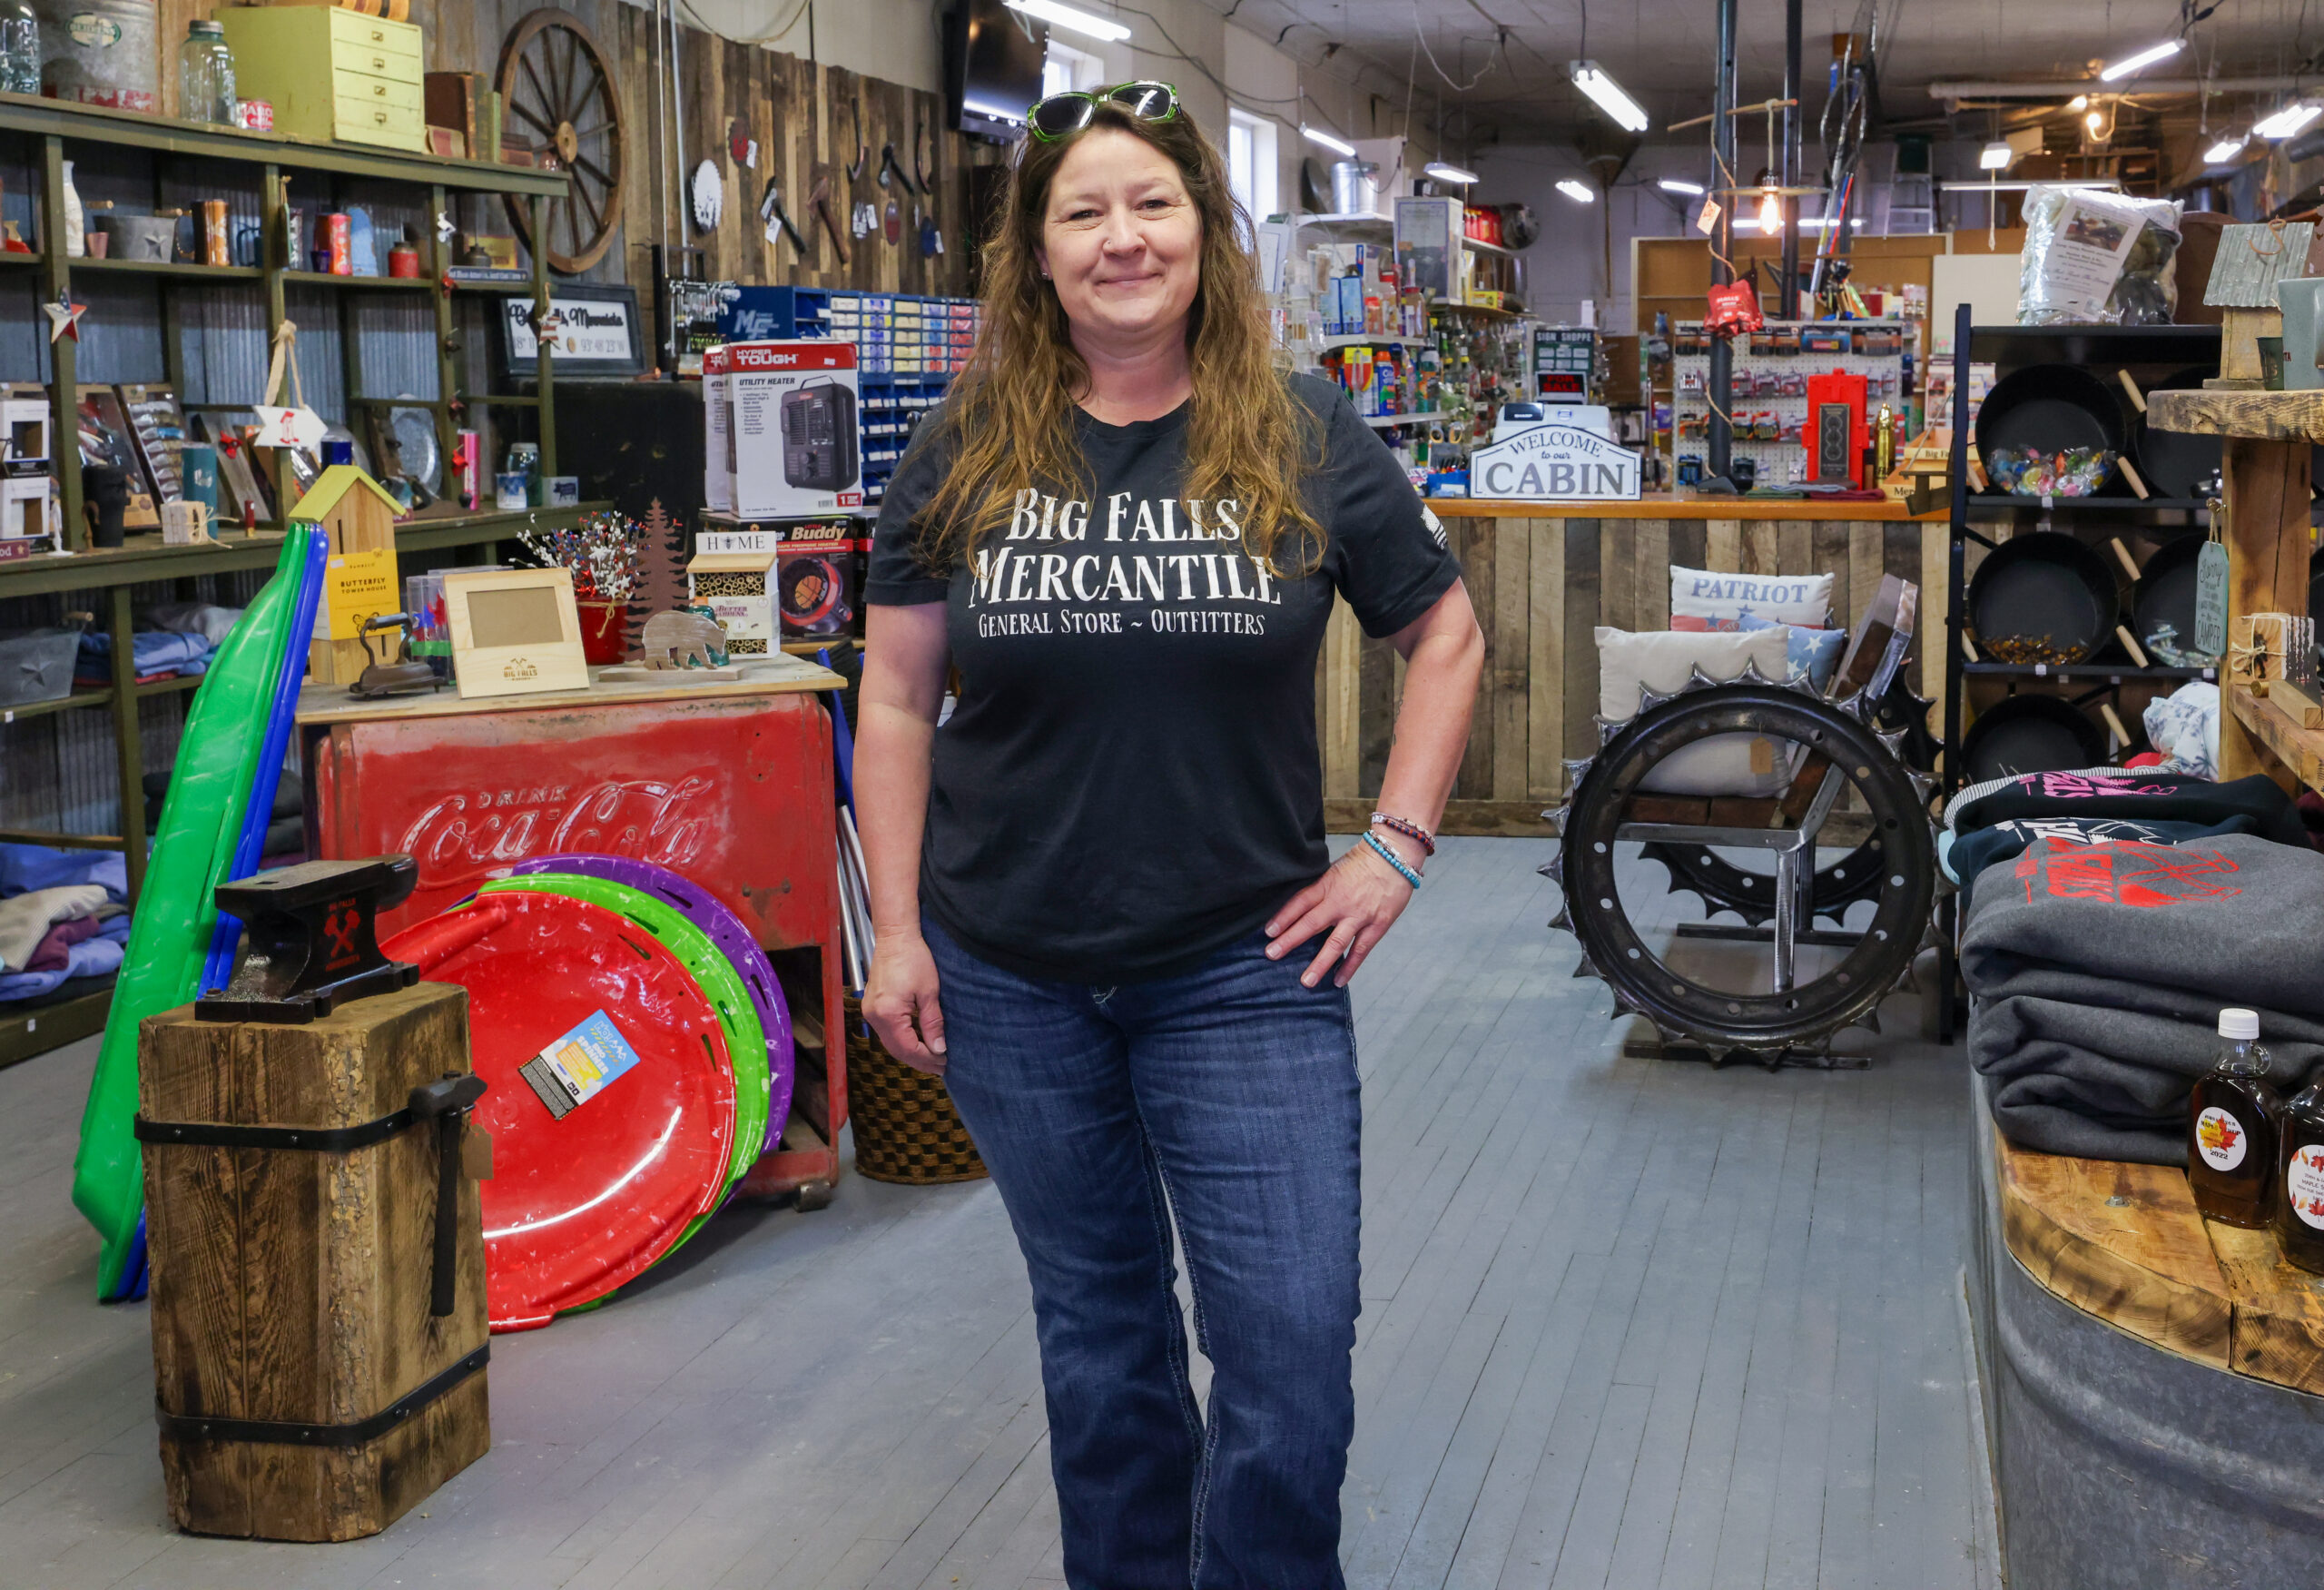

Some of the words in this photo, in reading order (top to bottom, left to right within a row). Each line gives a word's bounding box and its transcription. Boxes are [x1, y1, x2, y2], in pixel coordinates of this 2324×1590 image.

[737, 354, 797, 365] TOUGH
[1543, 382, 1581, 392] SALE
[1509, 431, 1603, 458] WELCOME
[1541, 450, 1551, 459] to
[1485, 462, 1625, 495] CABIN
[1005, 488, 1088, 541] BIG
[1104, 491, 1241, 542] FALLS
[792, 526, 847, 542] Buddy
[340, 578, 386, 588] BUTTERFLY
[969, 547, 1282, 608] MERCANTILE
[1691, 578, 1808, 604] PATRIOT
[979, 612, 1053, 637] GENERAL
[1061, 608, 1123, 635] STORE
[1151, 608, 1265, 636] OUTFITTERS
[478, 785, 570, 809] DRINK
[397, 775, 714, 891] Coca-Cola
[2302, 1179, 2319, 1189] MAPLE
